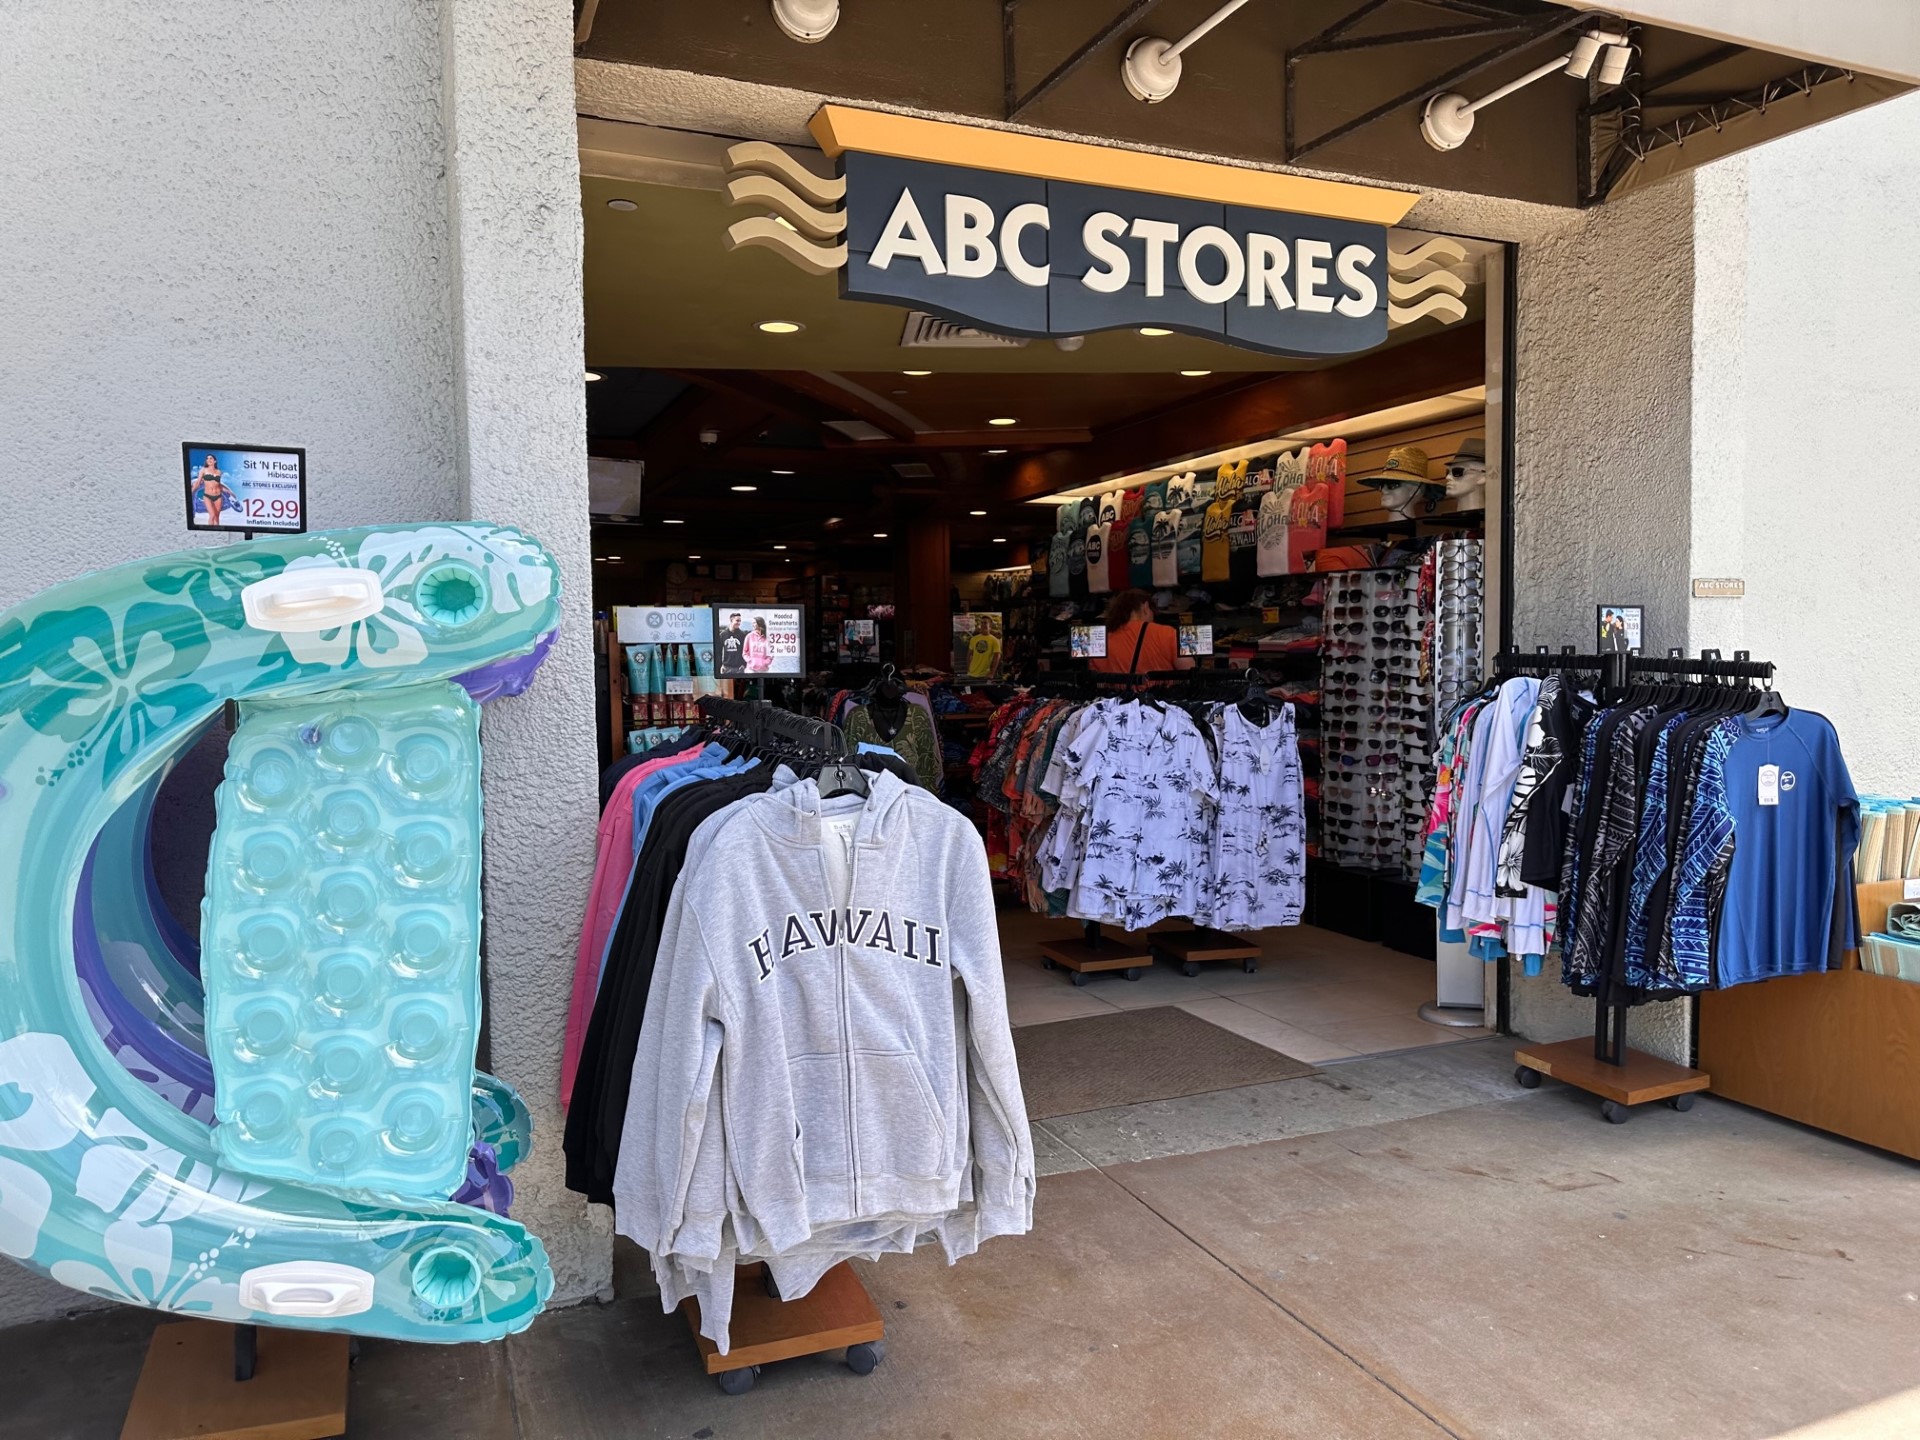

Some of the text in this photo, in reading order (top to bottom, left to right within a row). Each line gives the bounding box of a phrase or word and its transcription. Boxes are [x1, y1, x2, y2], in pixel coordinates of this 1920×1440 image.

[867, 187, 1378, 318] ABC STORES
[243, 460, 257, 469] Sit
[272, 461, 298, 471] Float
[267, 471, 298, 479] Hibiscus
[243, 498, 299, 519] 12.99
[1101, 510, 1115, 521] ABC
[1088, 541, 1100, 550] ABC
[665, 612, 695, 621] maui
[769, 633, 796, 644] 32.99
[770, 645, 775, 653] 2
[748, 906, 943, 983] HAWAII
